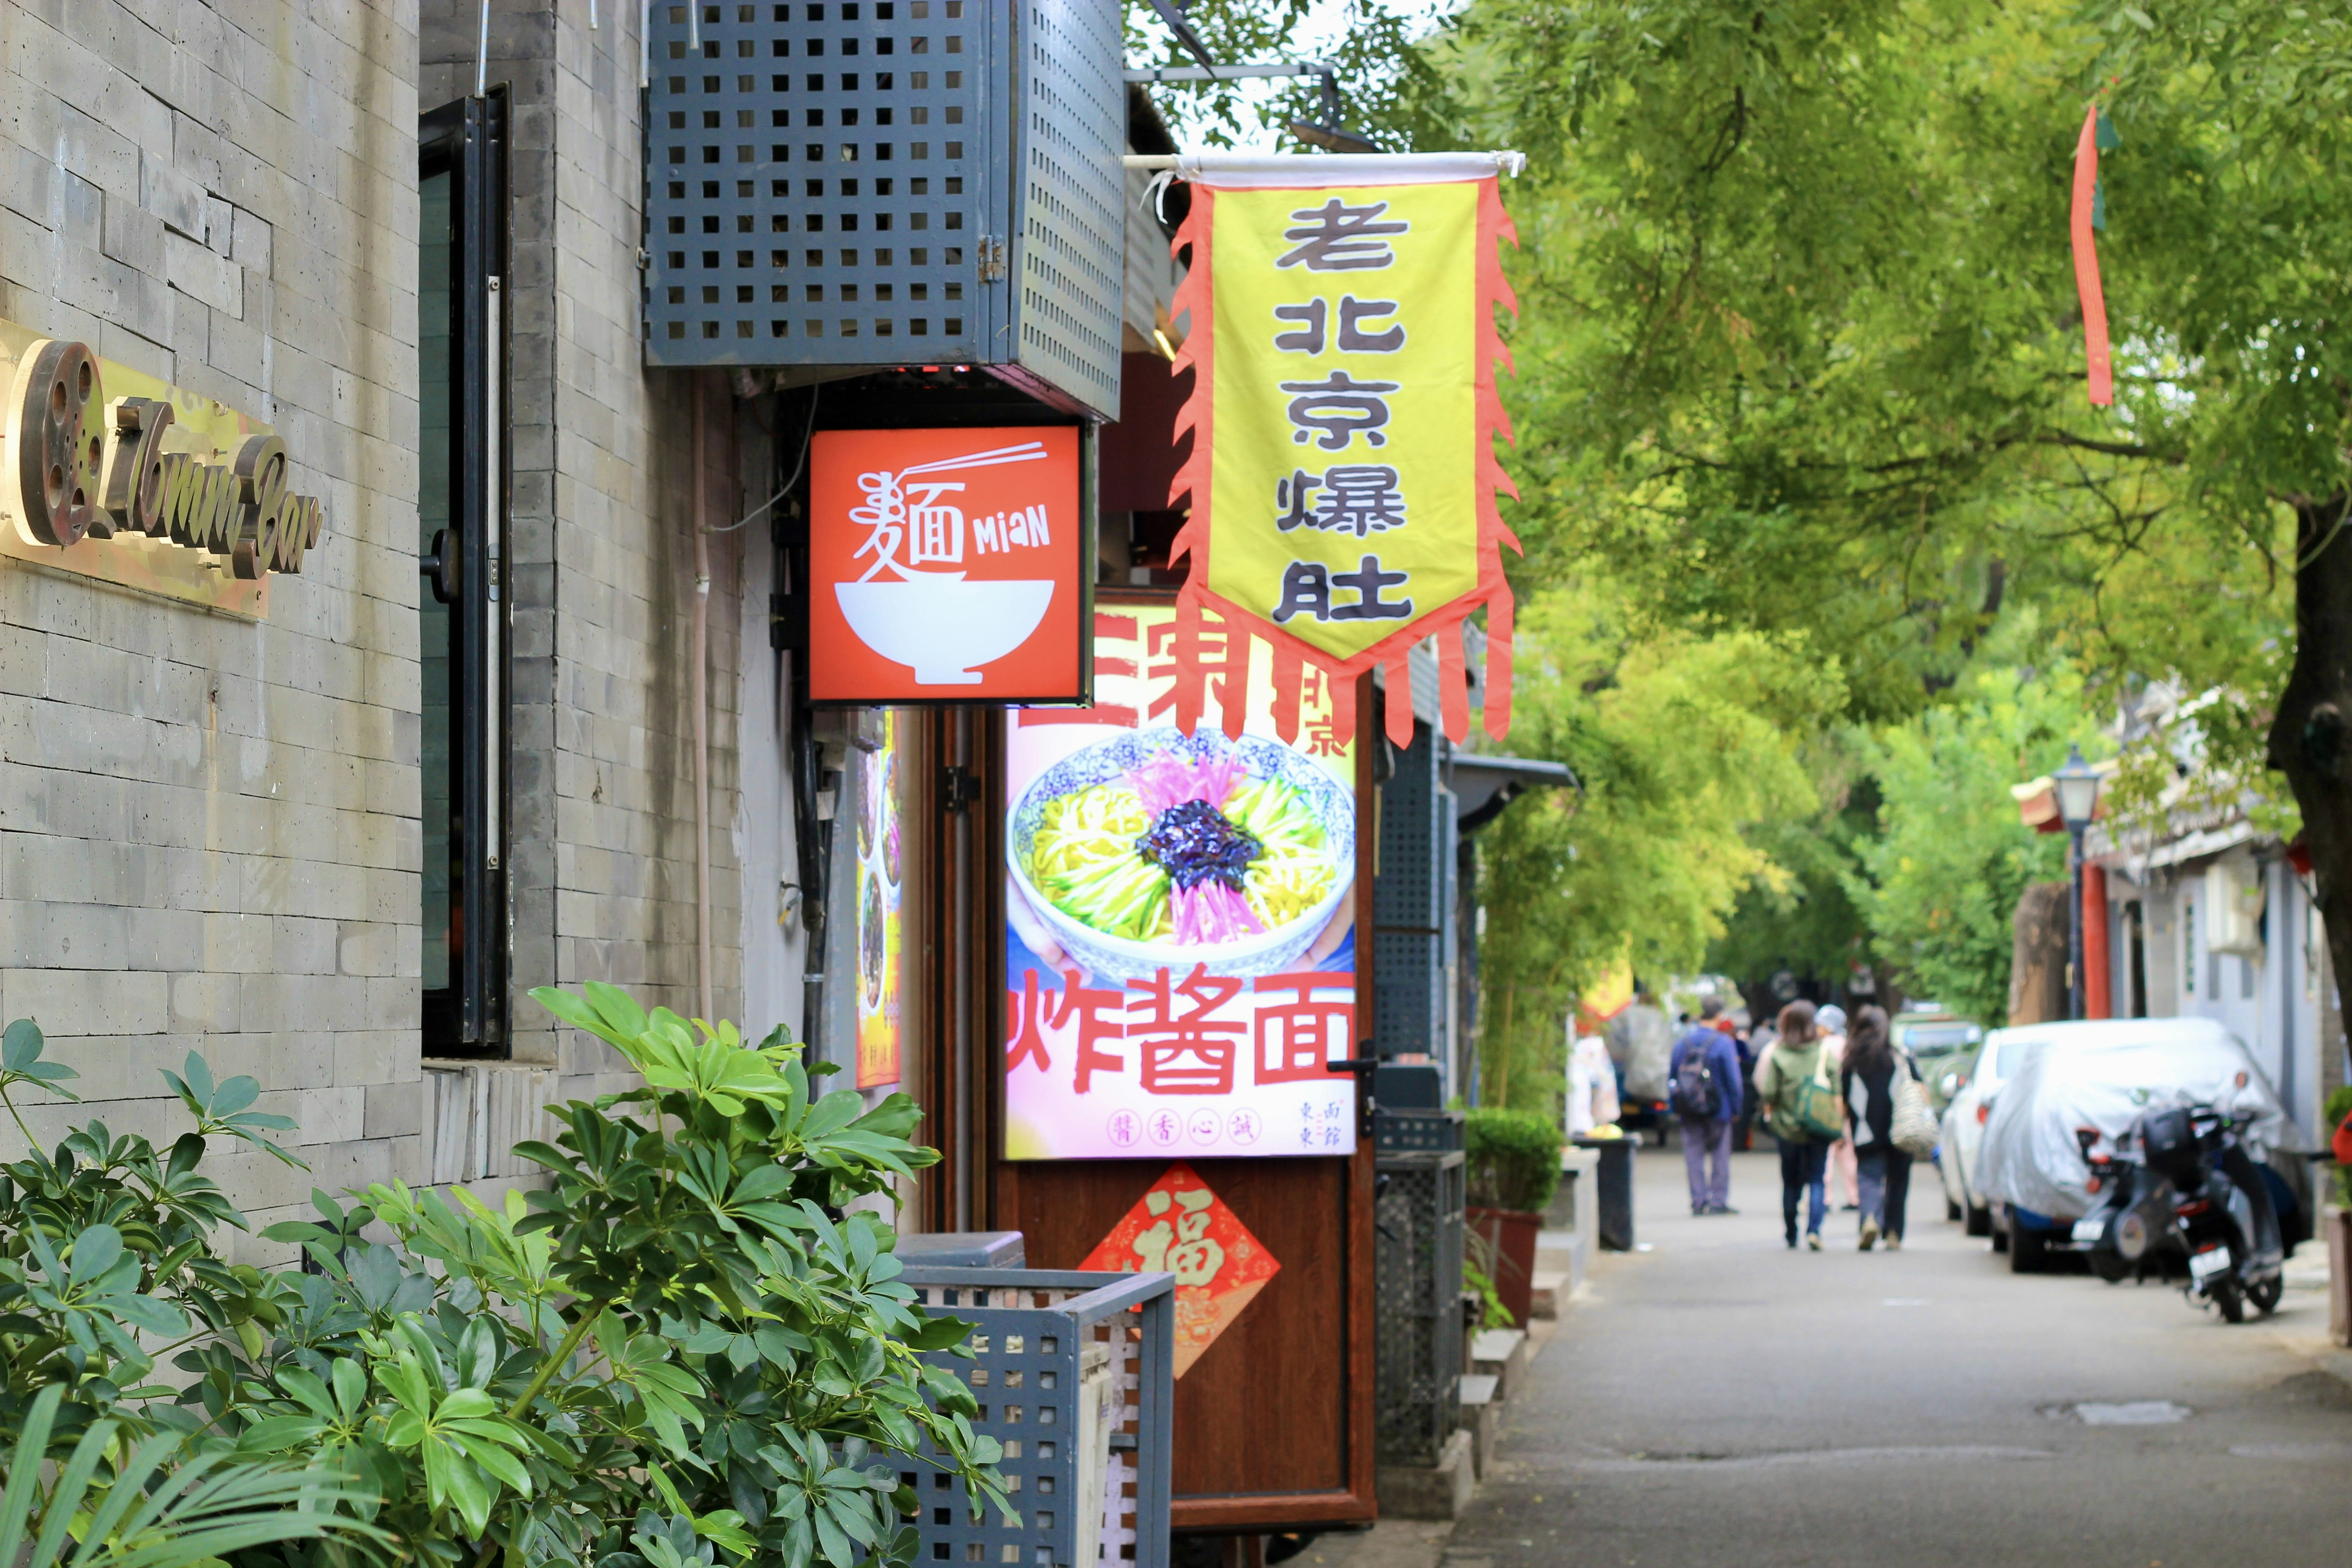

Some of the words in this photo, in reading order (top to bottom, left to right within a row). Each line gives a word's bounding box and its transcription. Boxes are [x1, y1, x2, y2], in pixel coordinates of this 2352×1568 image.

[1275, 198, 1412, 622] 老北京爆肚
[233, 435, 323, 579] Bar
[1132, 1188, 1224, 1287] 福
